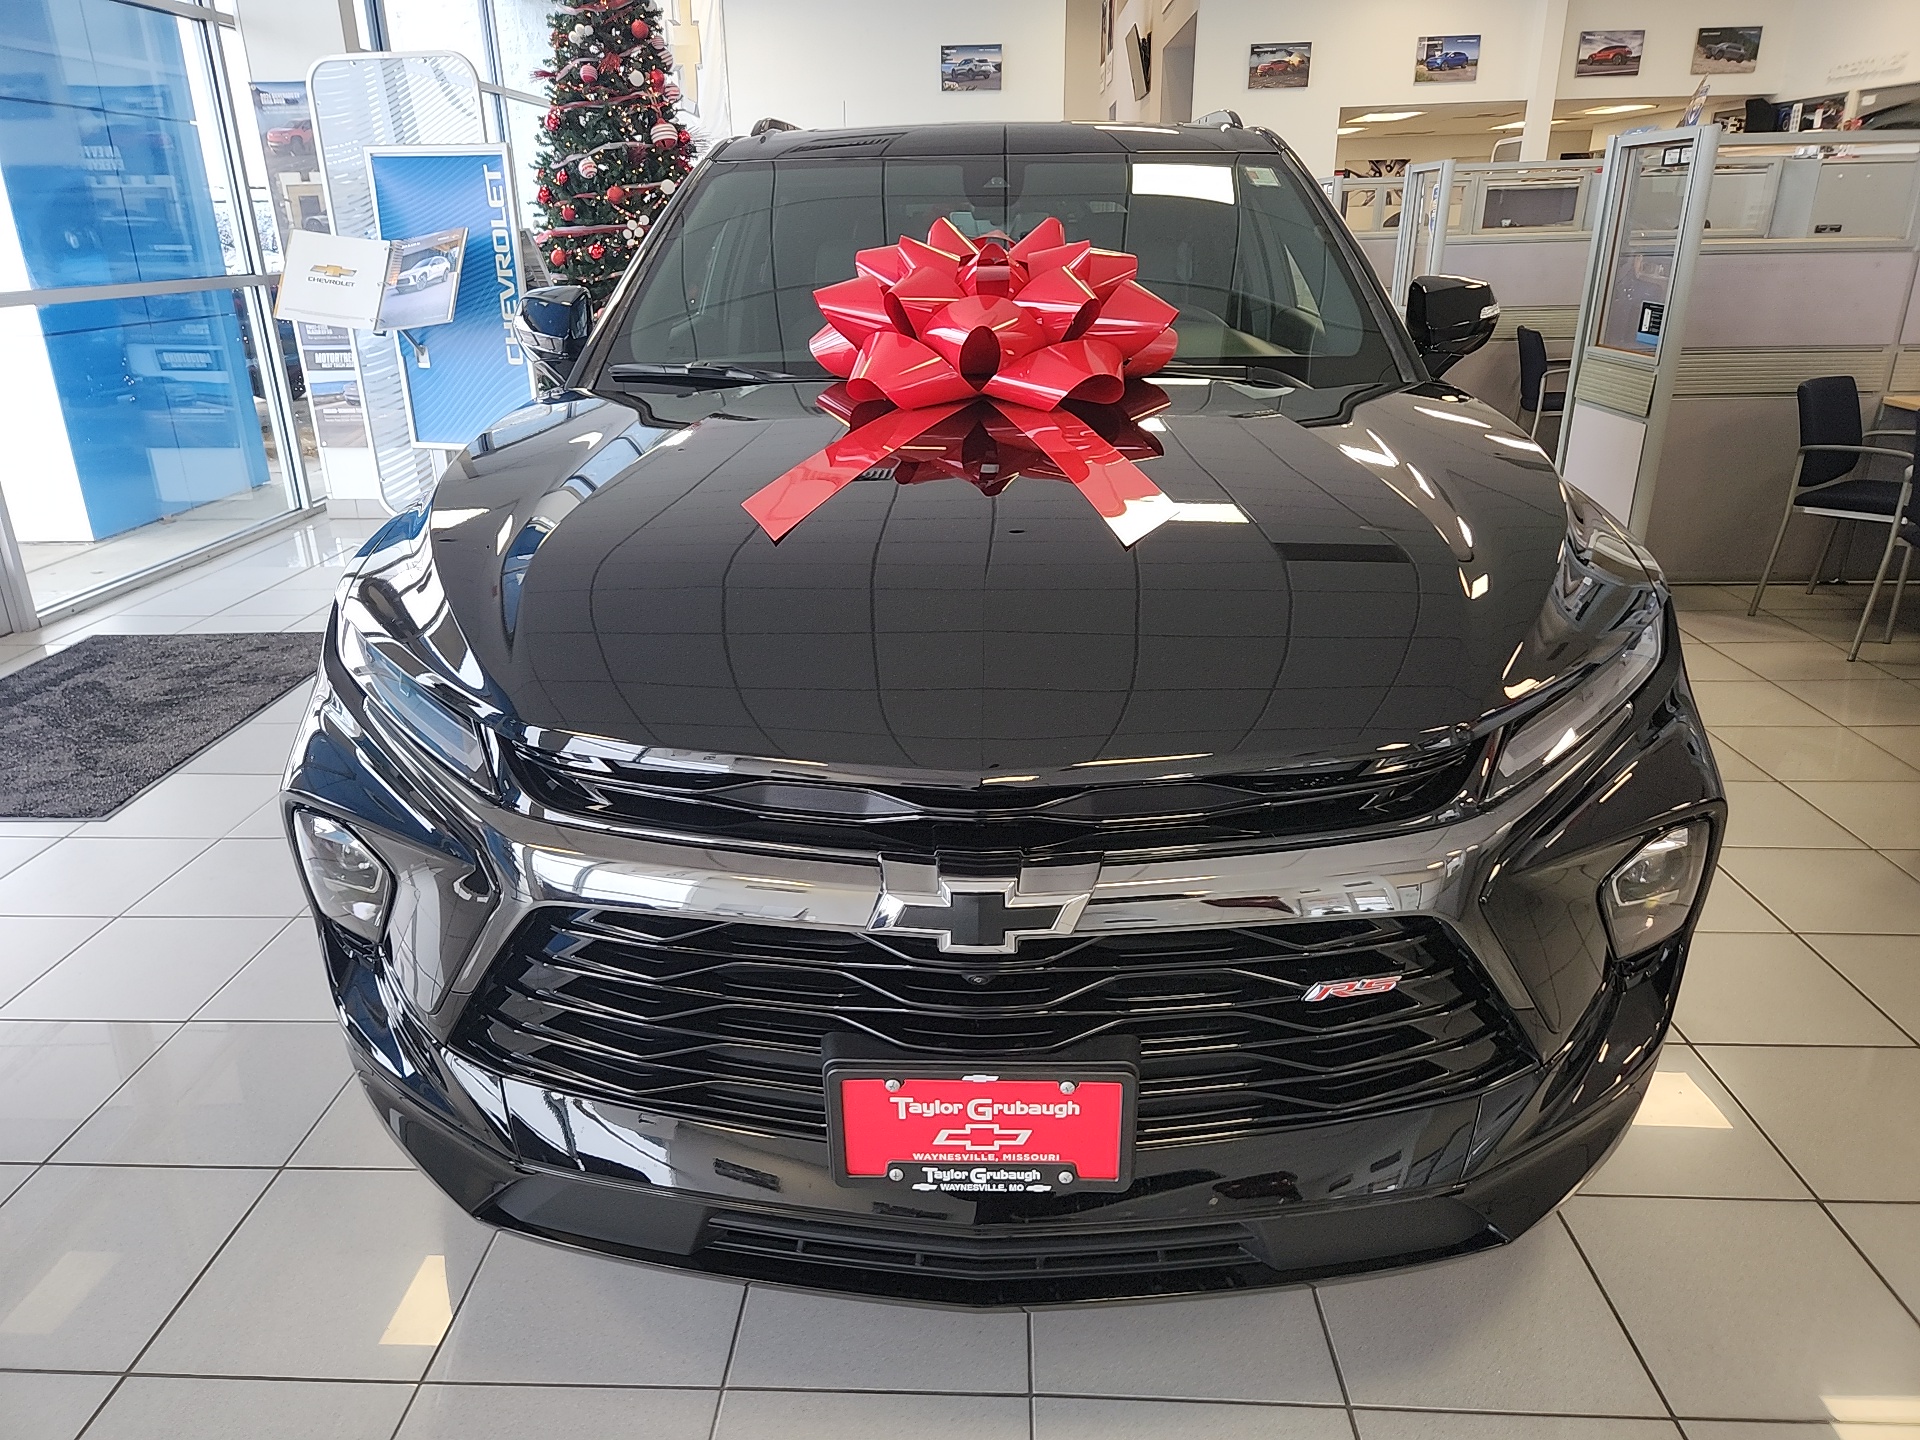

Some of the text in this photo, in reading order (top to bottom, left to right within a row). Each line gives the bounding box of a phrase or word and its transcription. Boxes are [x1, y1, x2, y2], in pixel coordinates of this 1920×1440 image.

[483, 164, 524, 366] CHEVROLET
[307, 276, 356, 287] CHEVROLET
[1302, 976, 1402, 1001] RS
[889, 1096, 1081, 1121] Taylor Grubaugh
[912, 1152, 1061, 1163] WAYNESVILLE, MISSOURI
[921, 1166, 1042, 1184] Taylor Grubaugh
[939, 1183, 1025, 1193] WAYNESVILLE, MO
